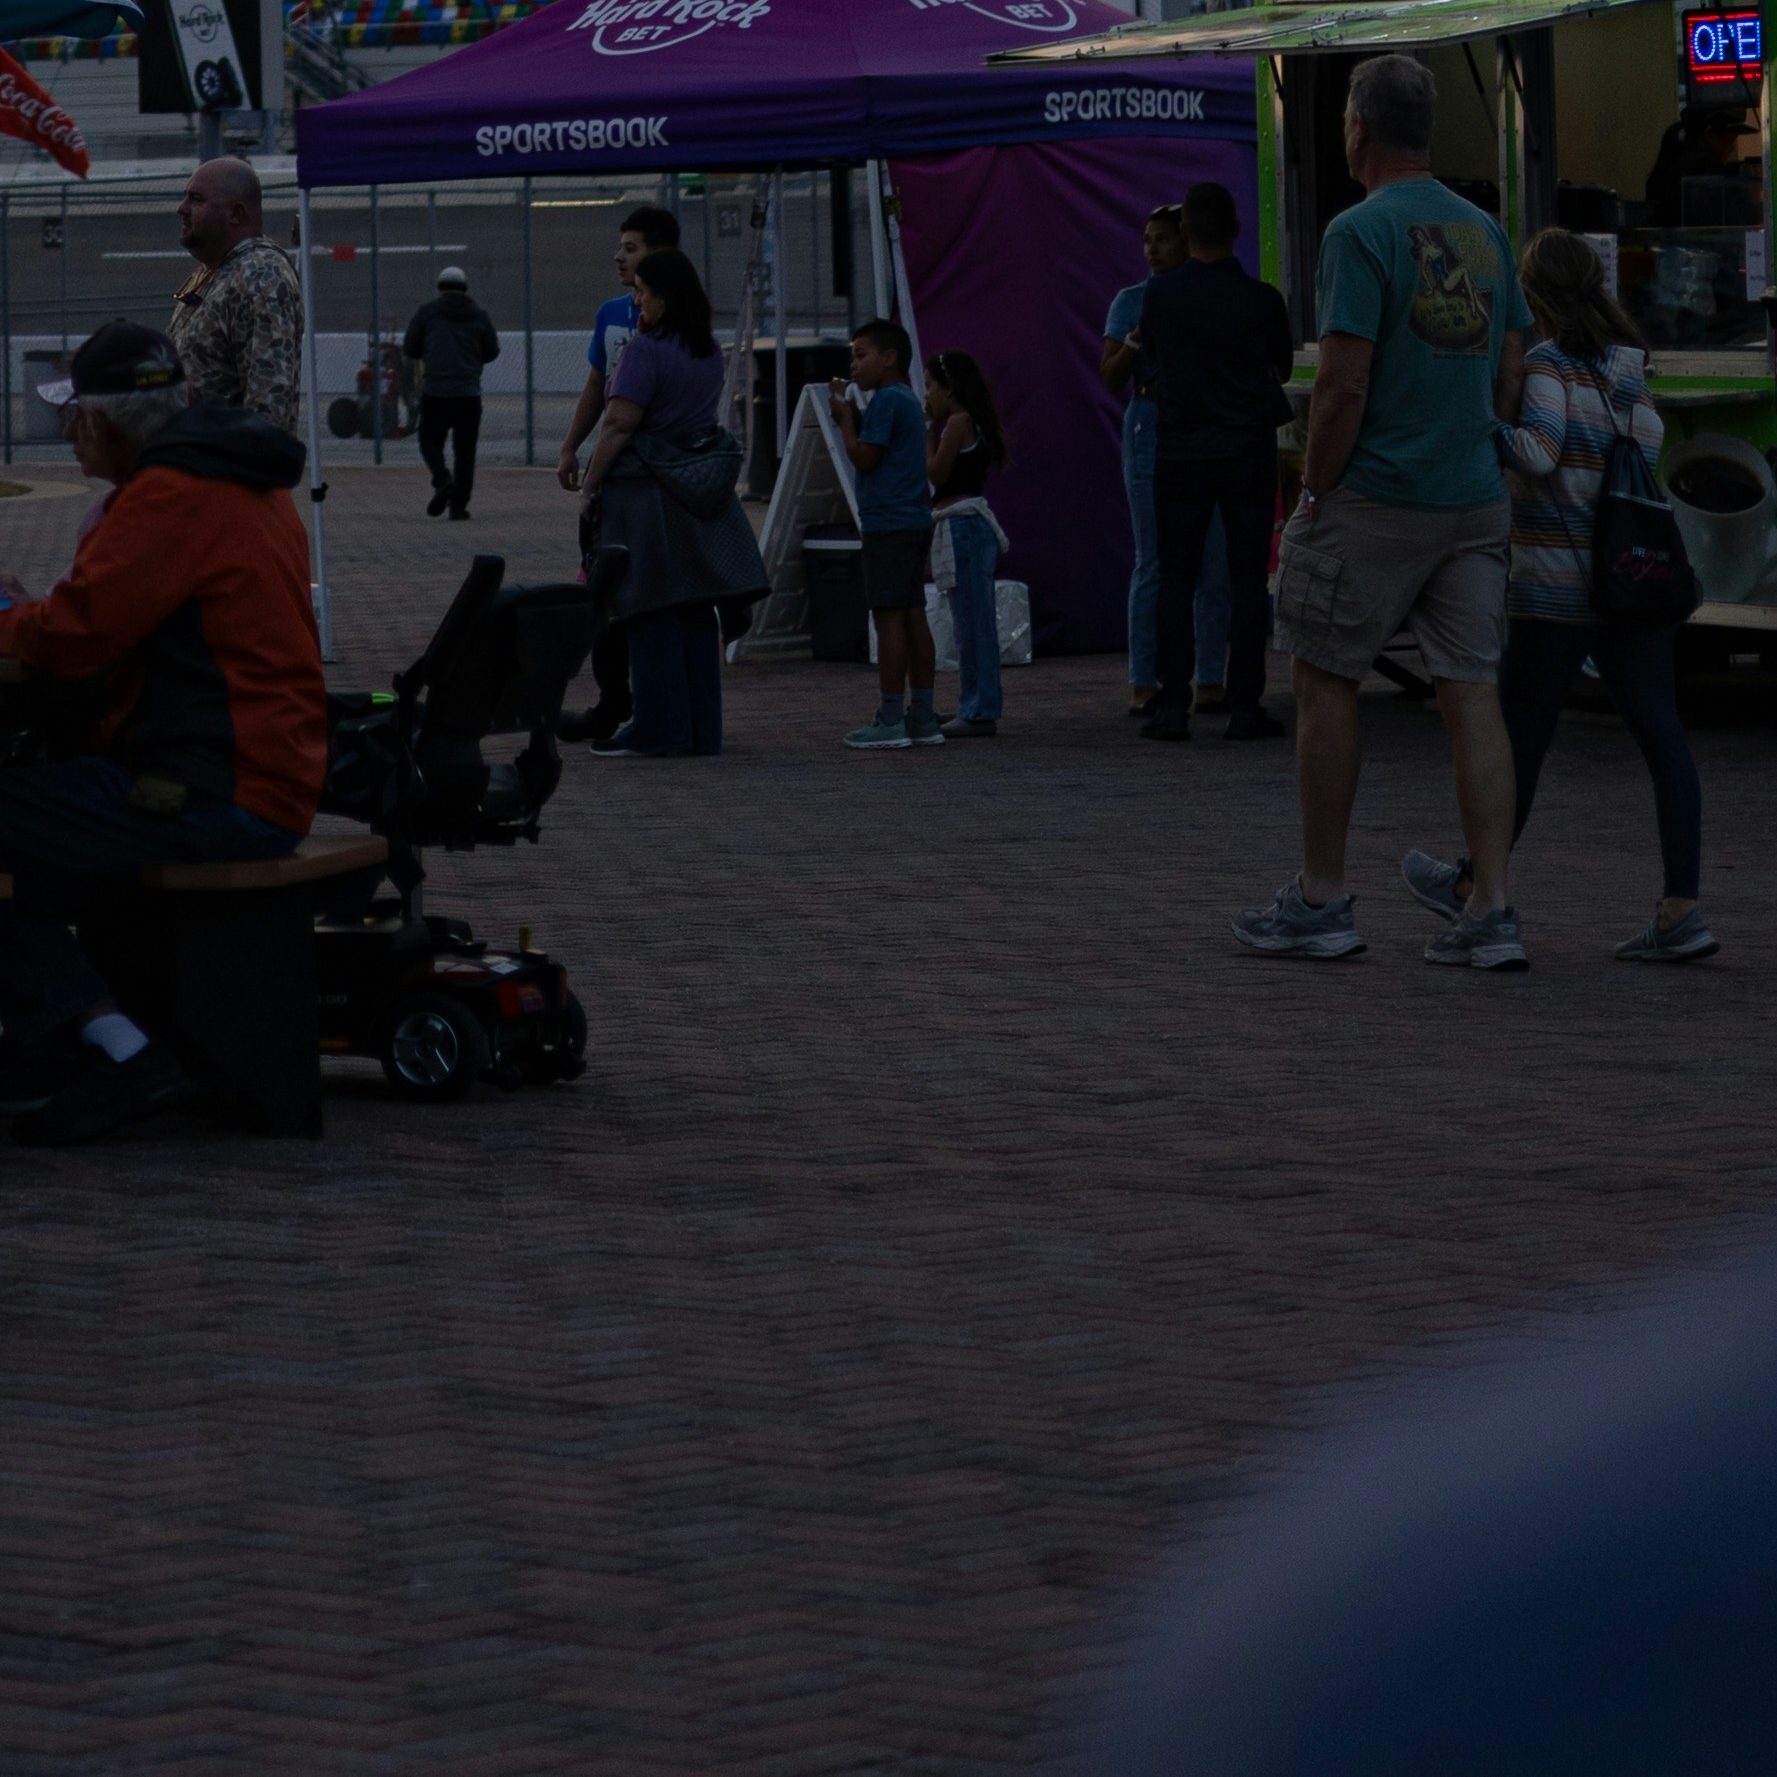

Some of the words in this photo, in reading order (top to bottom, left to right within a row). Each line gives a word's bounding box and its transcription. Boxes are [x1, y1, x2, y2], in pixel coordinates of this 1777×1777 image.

[1005, 3, 1054, 20] BET
[615, 25, 672, 44] BET
[1694, 20, 1761, 61] OPE
[1044, 87, 1206, 124] SPORTSBOOK
[475, 116, 669, 157] SPORTSBOOK
